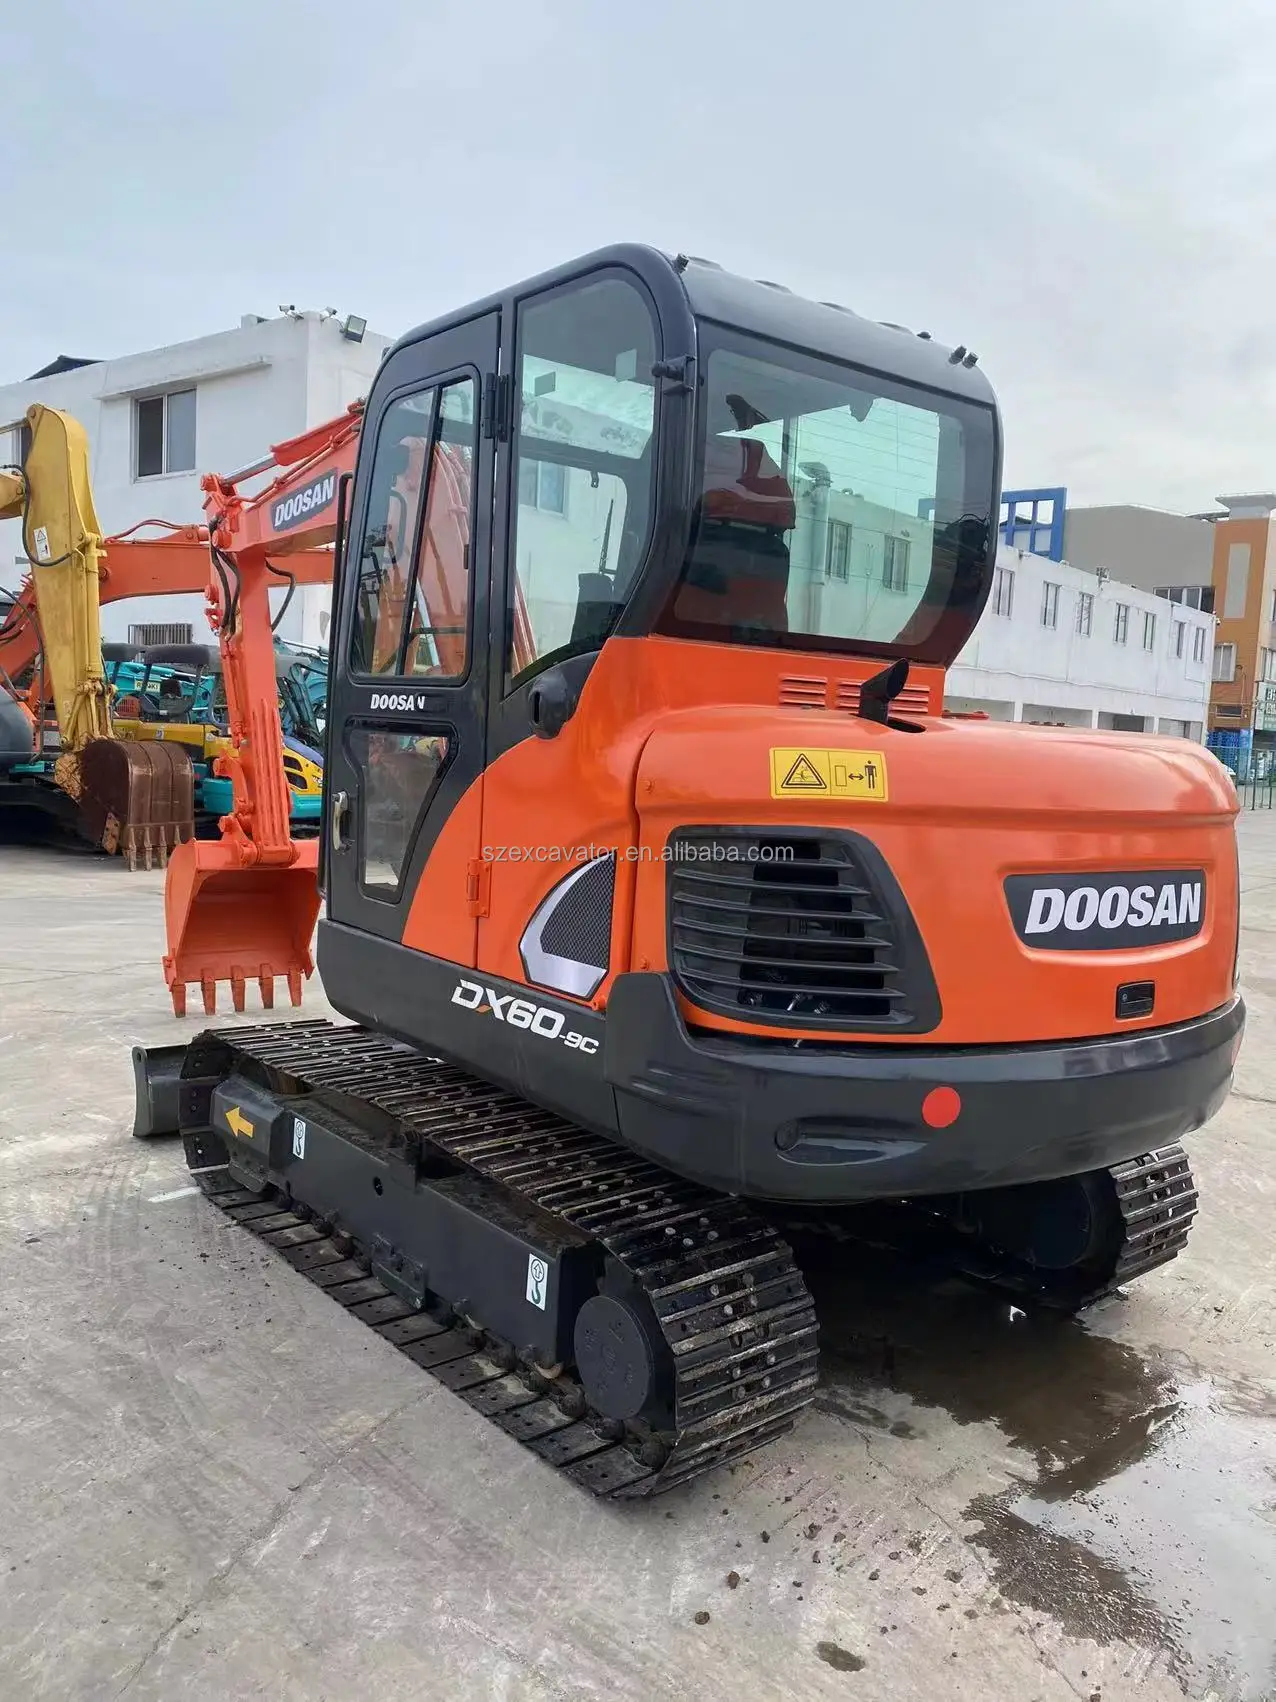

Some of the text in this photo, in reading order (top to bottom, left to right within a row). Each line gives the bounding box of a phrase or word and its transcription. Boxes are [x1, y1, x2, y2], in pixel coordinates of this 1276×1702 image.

[274, 475, 335, 527] DOOSAN
[370, 694, 425, 711] DOOSAN
[1024, 882, 1201, 934] DOOSAN
